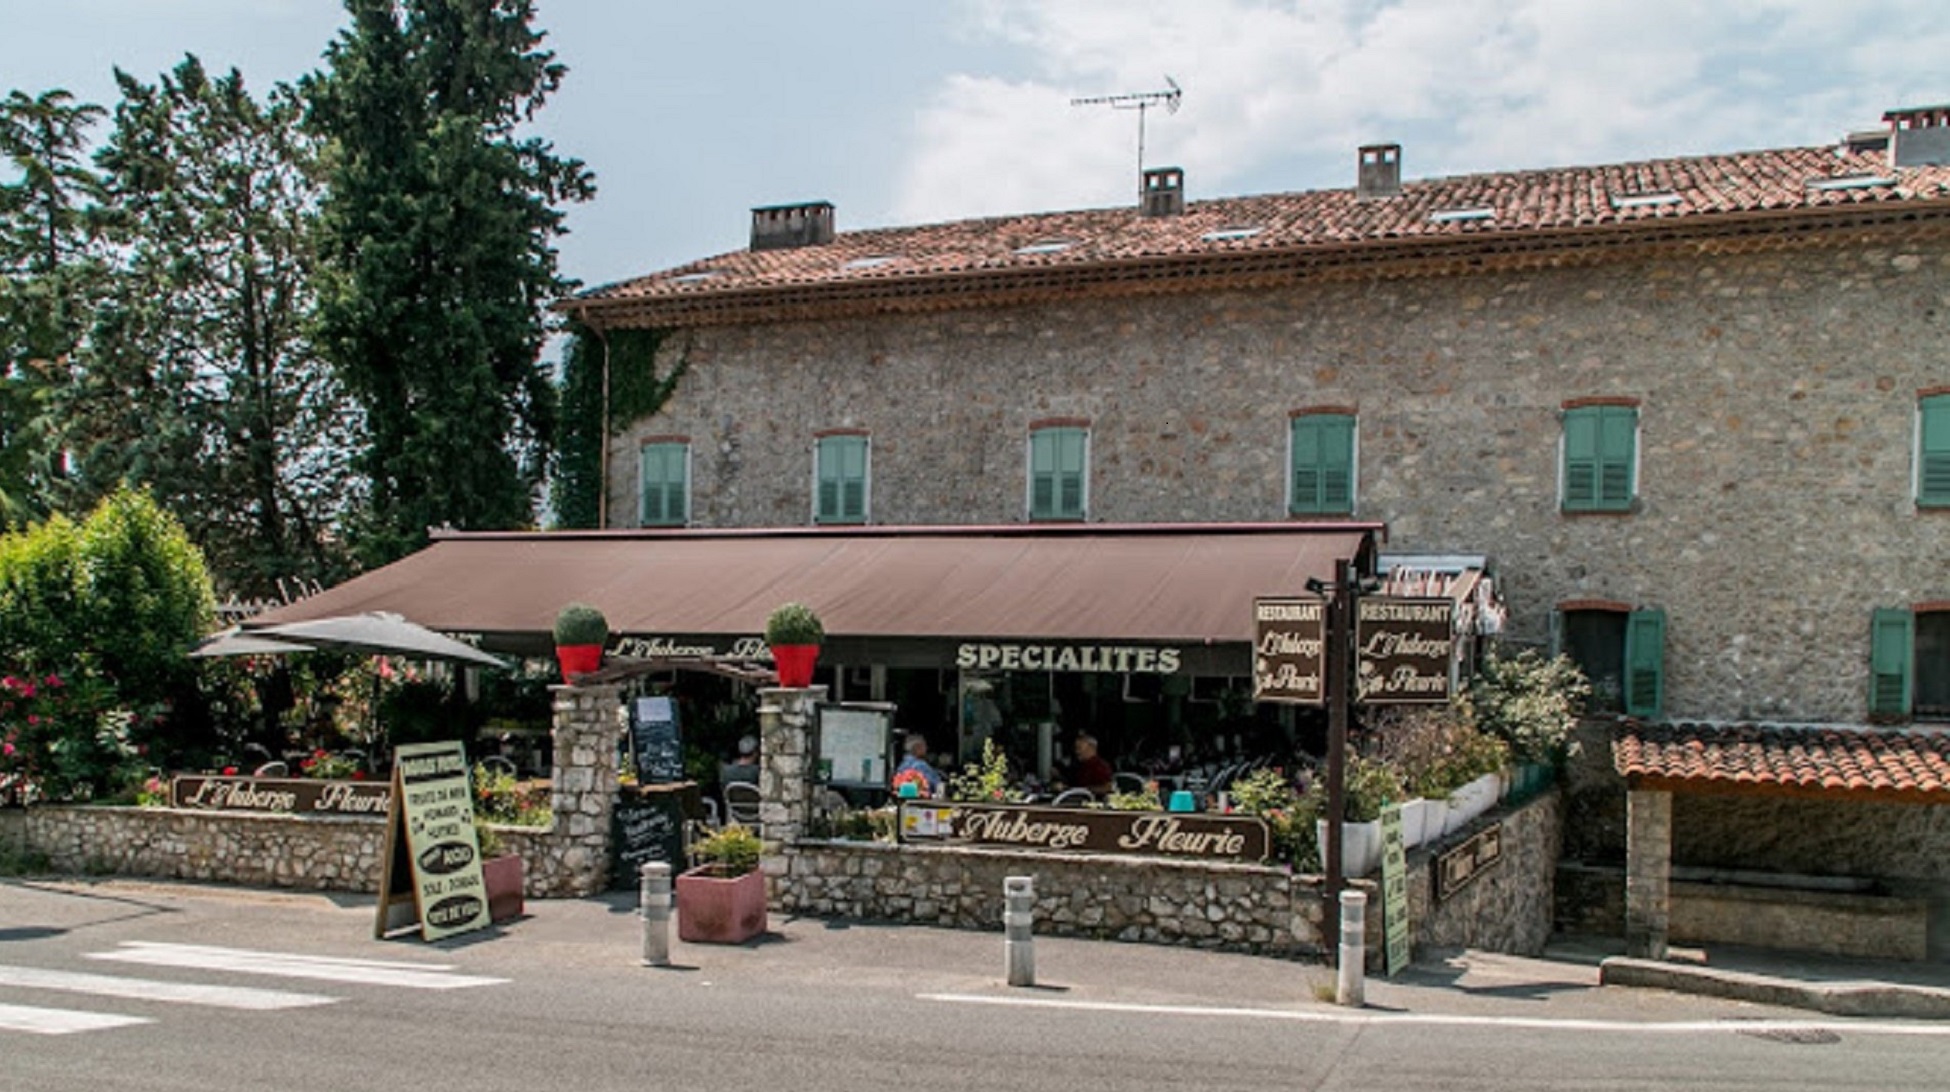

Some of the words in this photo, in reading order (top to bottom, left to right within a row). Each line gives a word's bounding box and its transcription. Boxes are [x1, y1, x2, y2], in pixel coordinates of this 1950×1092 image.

[1258, 605, 1321, 620] RESTAURANT
[1360, 603, 1450, 621] RESTAURANT
[957, 644, 1180, 673] SPECIALITES
[952, 808, 1088, 848] 'Auberge
[1118, 816, 1245, 854] Fleurie
